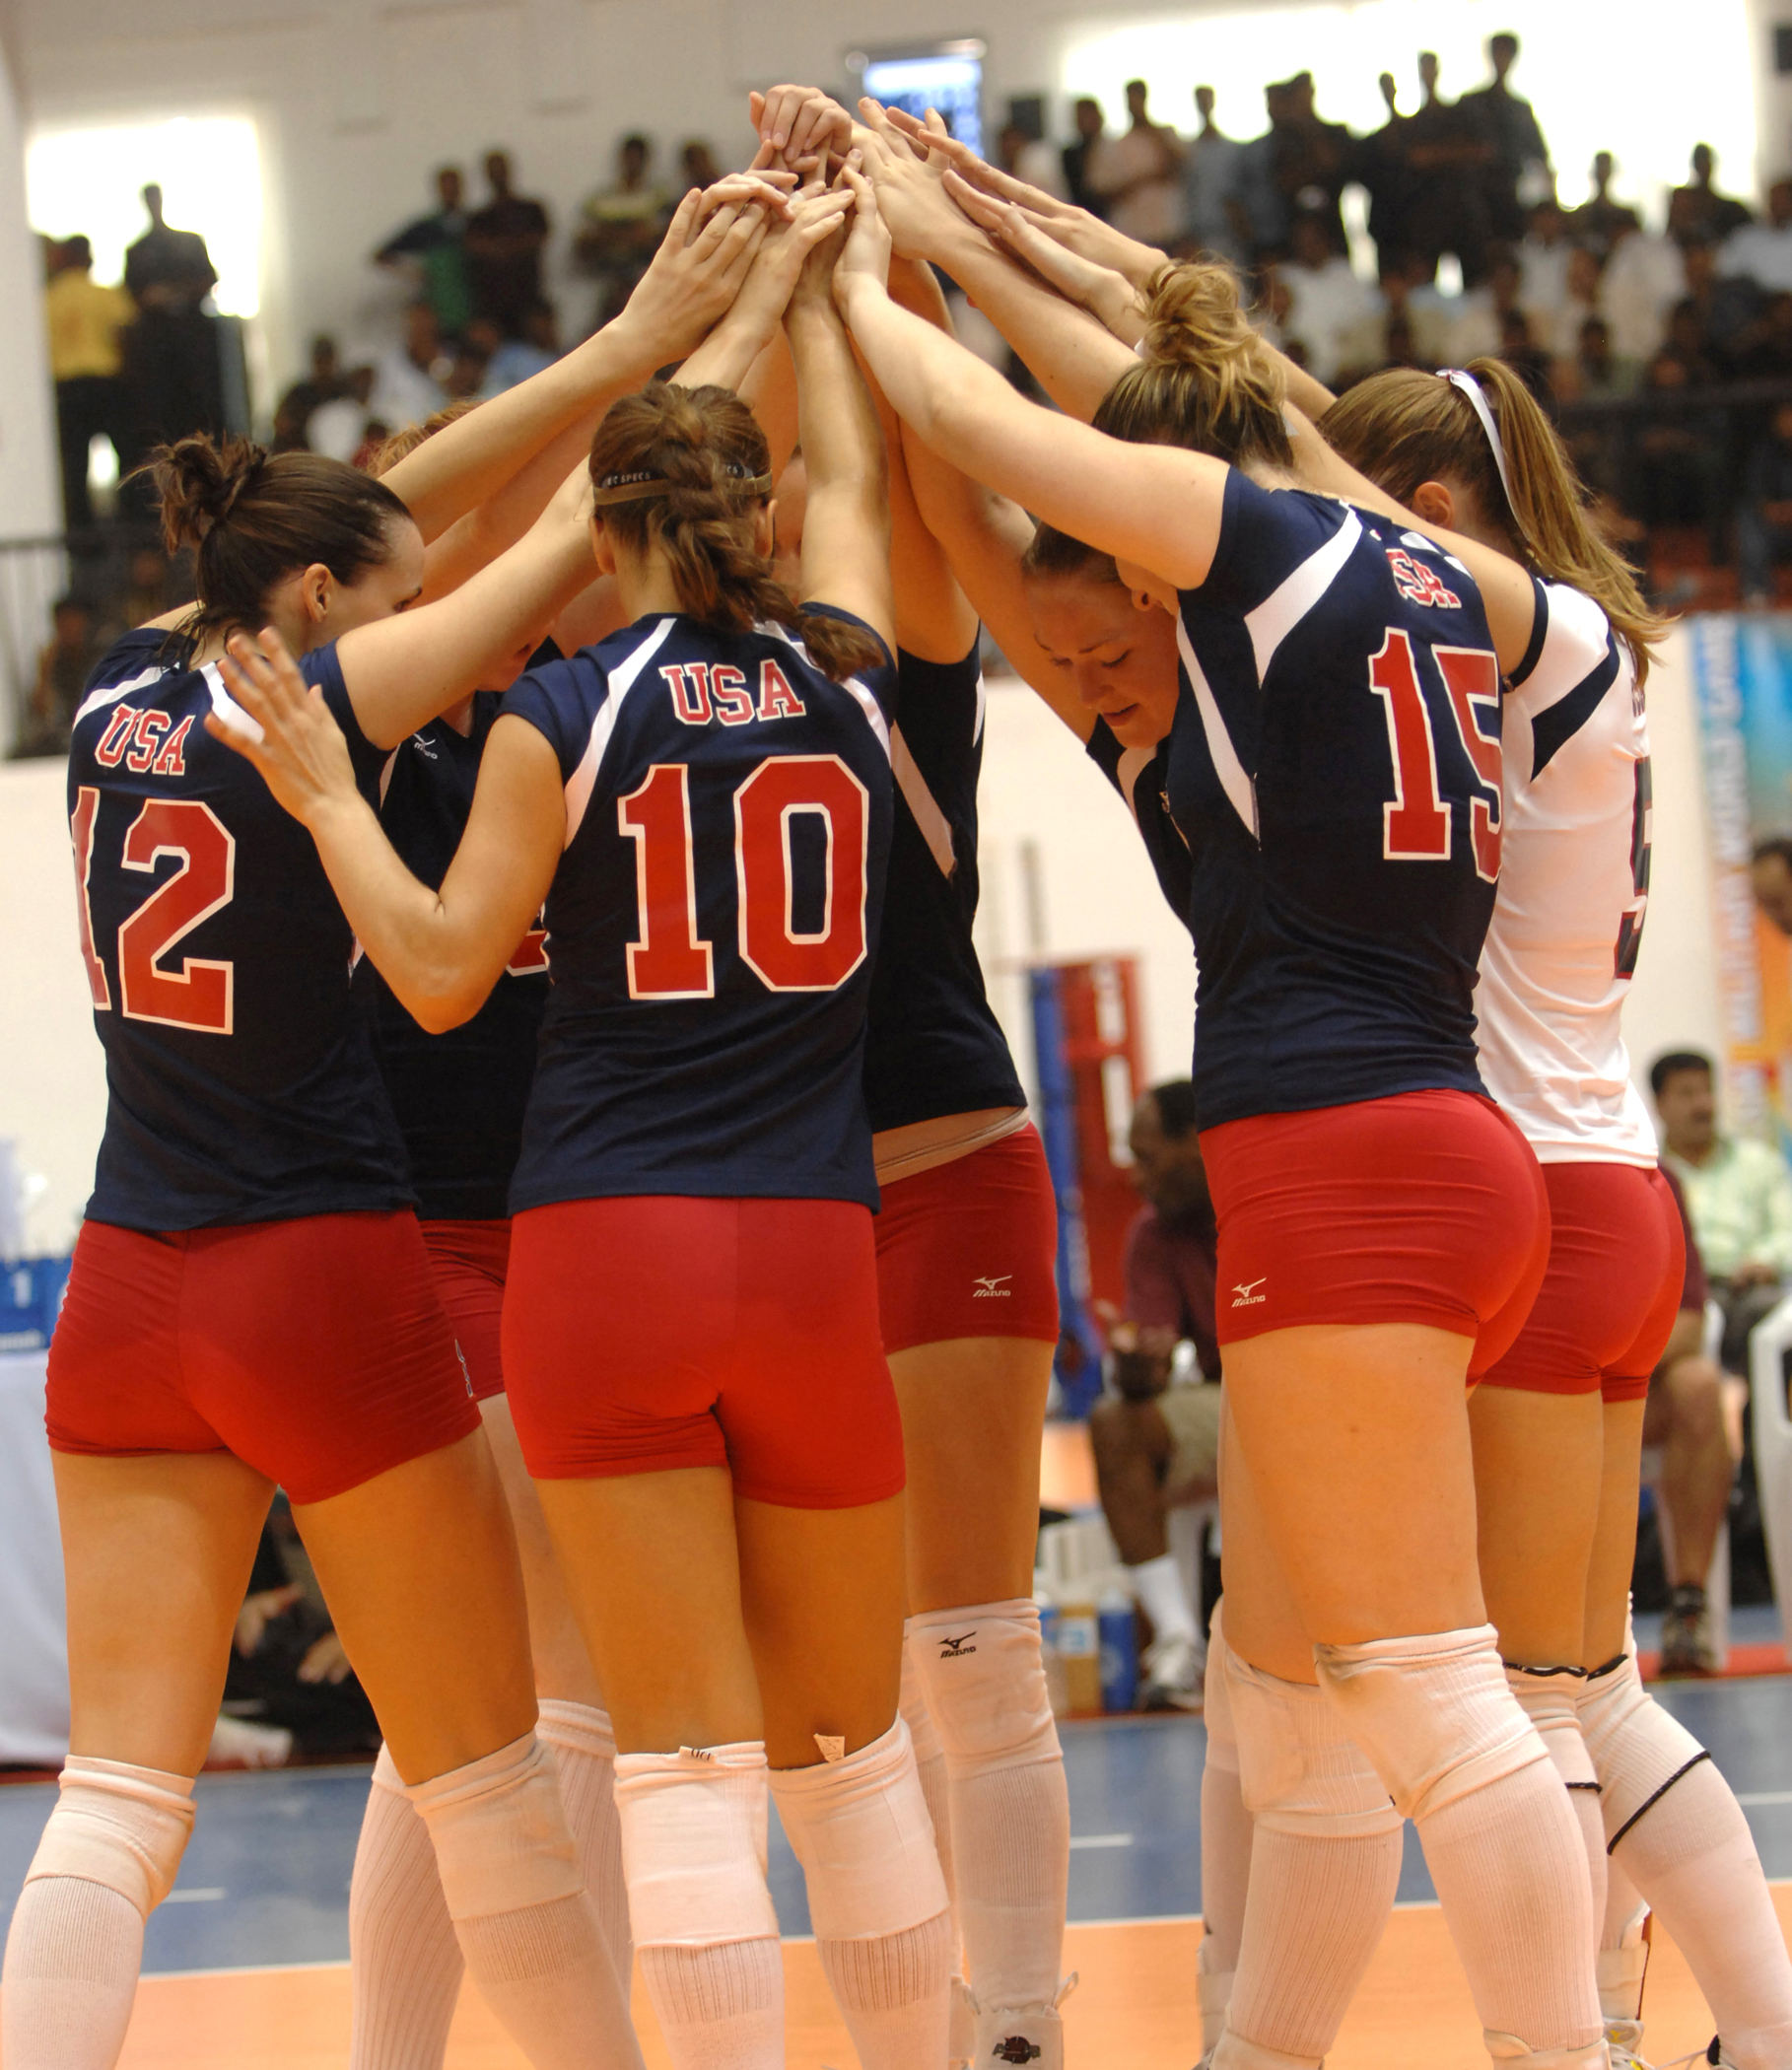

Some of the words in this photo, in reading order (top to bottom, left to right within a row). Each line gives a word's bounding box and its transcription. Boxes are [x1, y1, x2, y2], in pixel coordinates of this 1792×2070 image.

[620, 472, 651, 484] SPECS
[95, 704, 195, 776] USA
[658, 658, 806, 726] USA
[1367, 626, 1503, 884] 15
[71, 786, 236, 1035] 12
[617, 754, 869, 1000] 10
